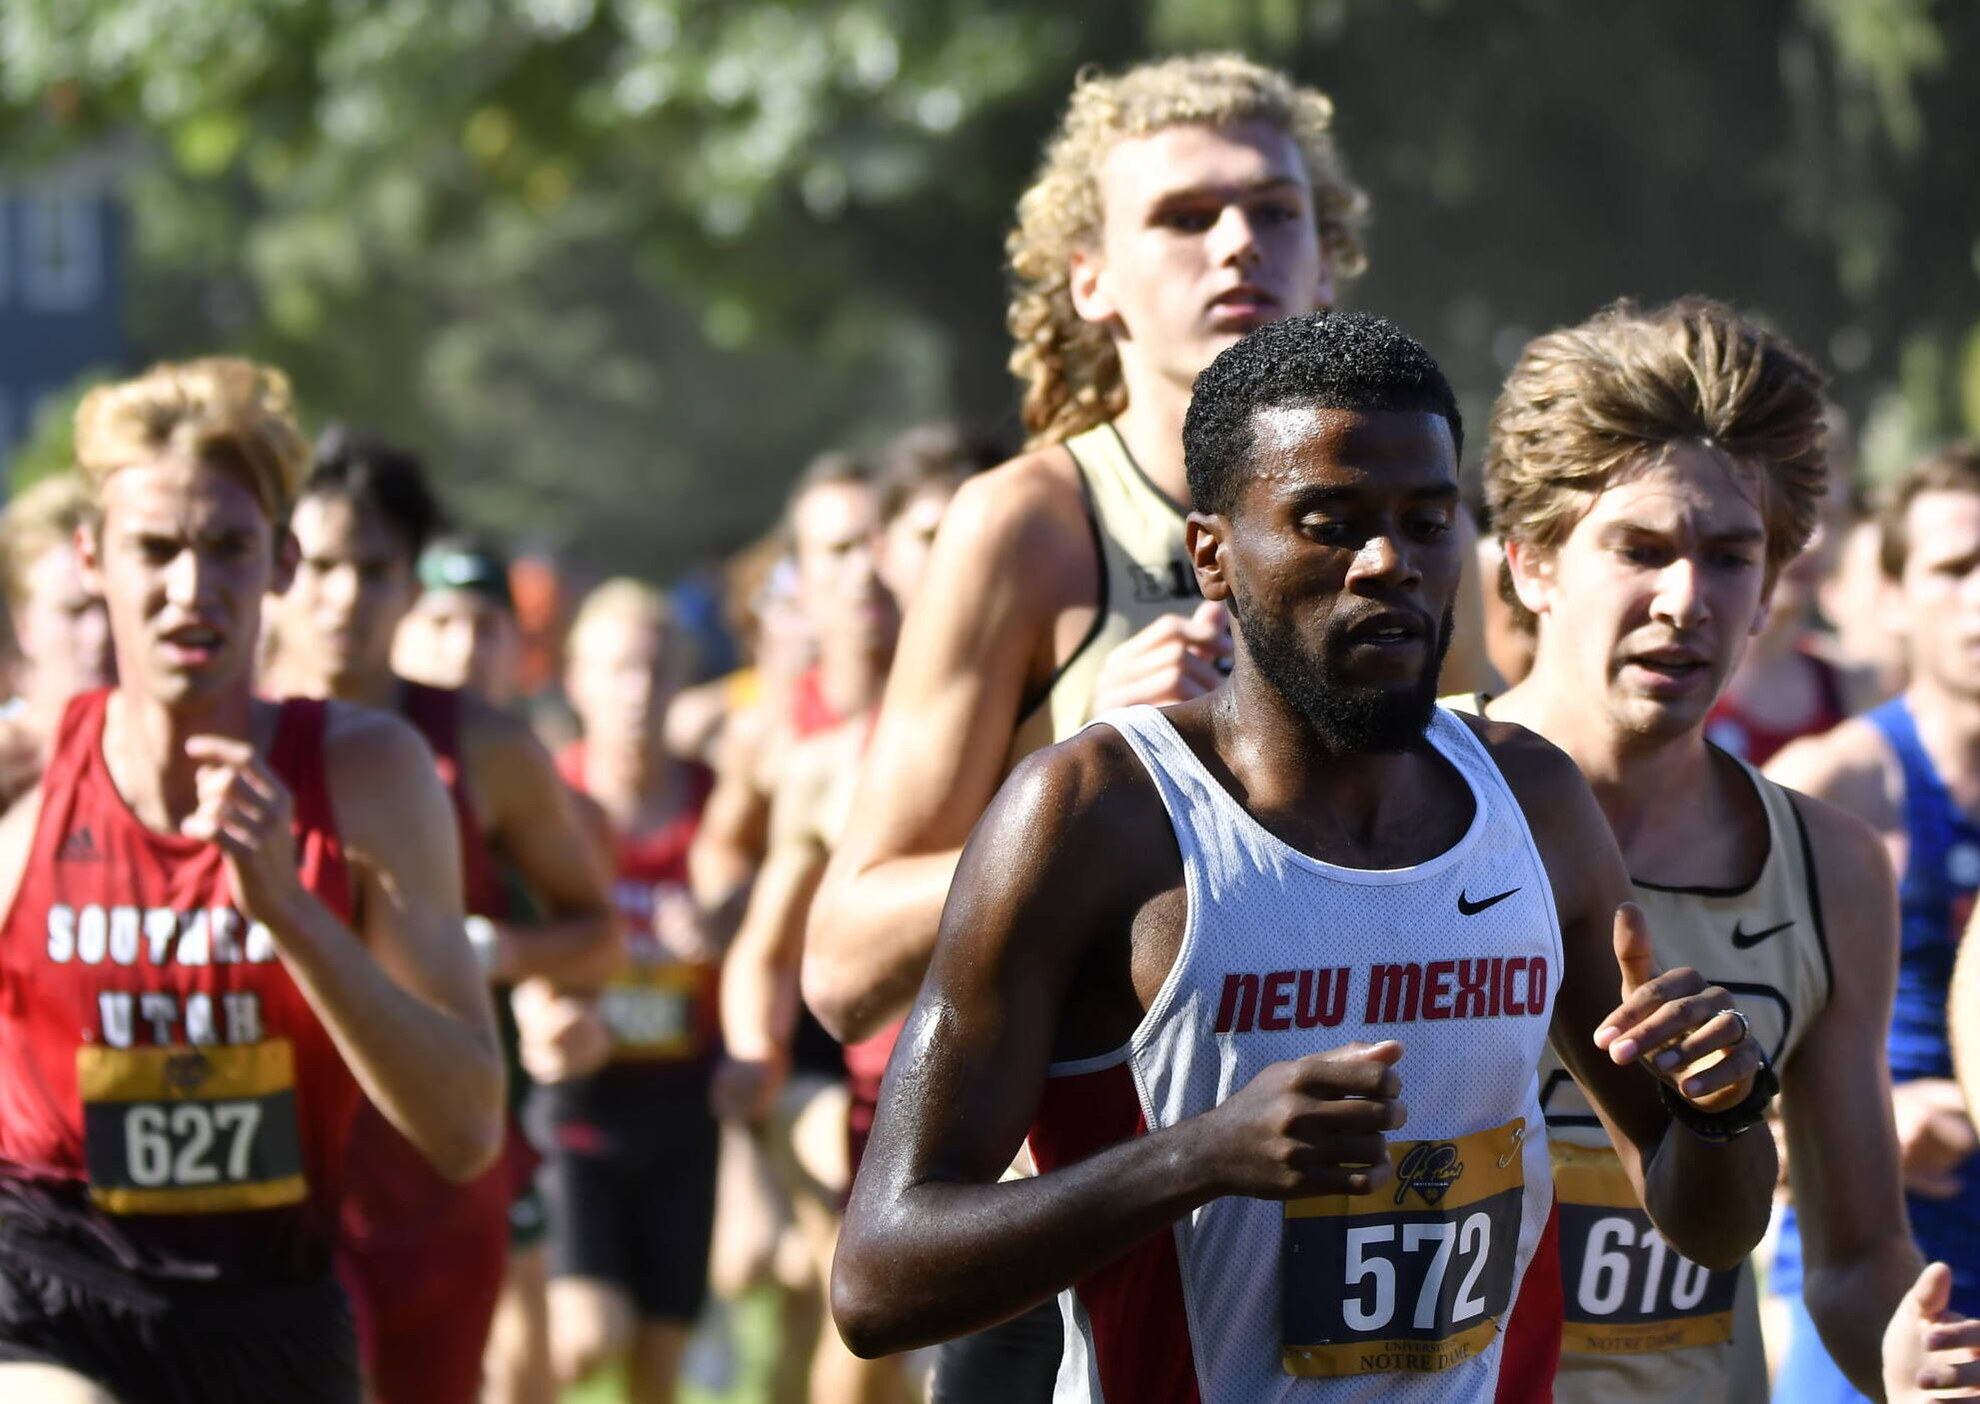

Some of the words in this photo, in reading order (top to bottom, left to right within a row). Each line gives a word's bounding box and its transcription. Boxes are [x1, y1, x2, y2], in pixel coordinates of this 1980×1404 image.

[99, 991, 262, 1047] UTAH
[1214, 967, 1351, 1033] NEW
[1364, 955, 1547, 1024] MEXICO
[124, 1102, 261, 1186] 627
[1343, 1212, 1491, 1331] 572
[1360, 1353, 1432, 1371] NOTRE
